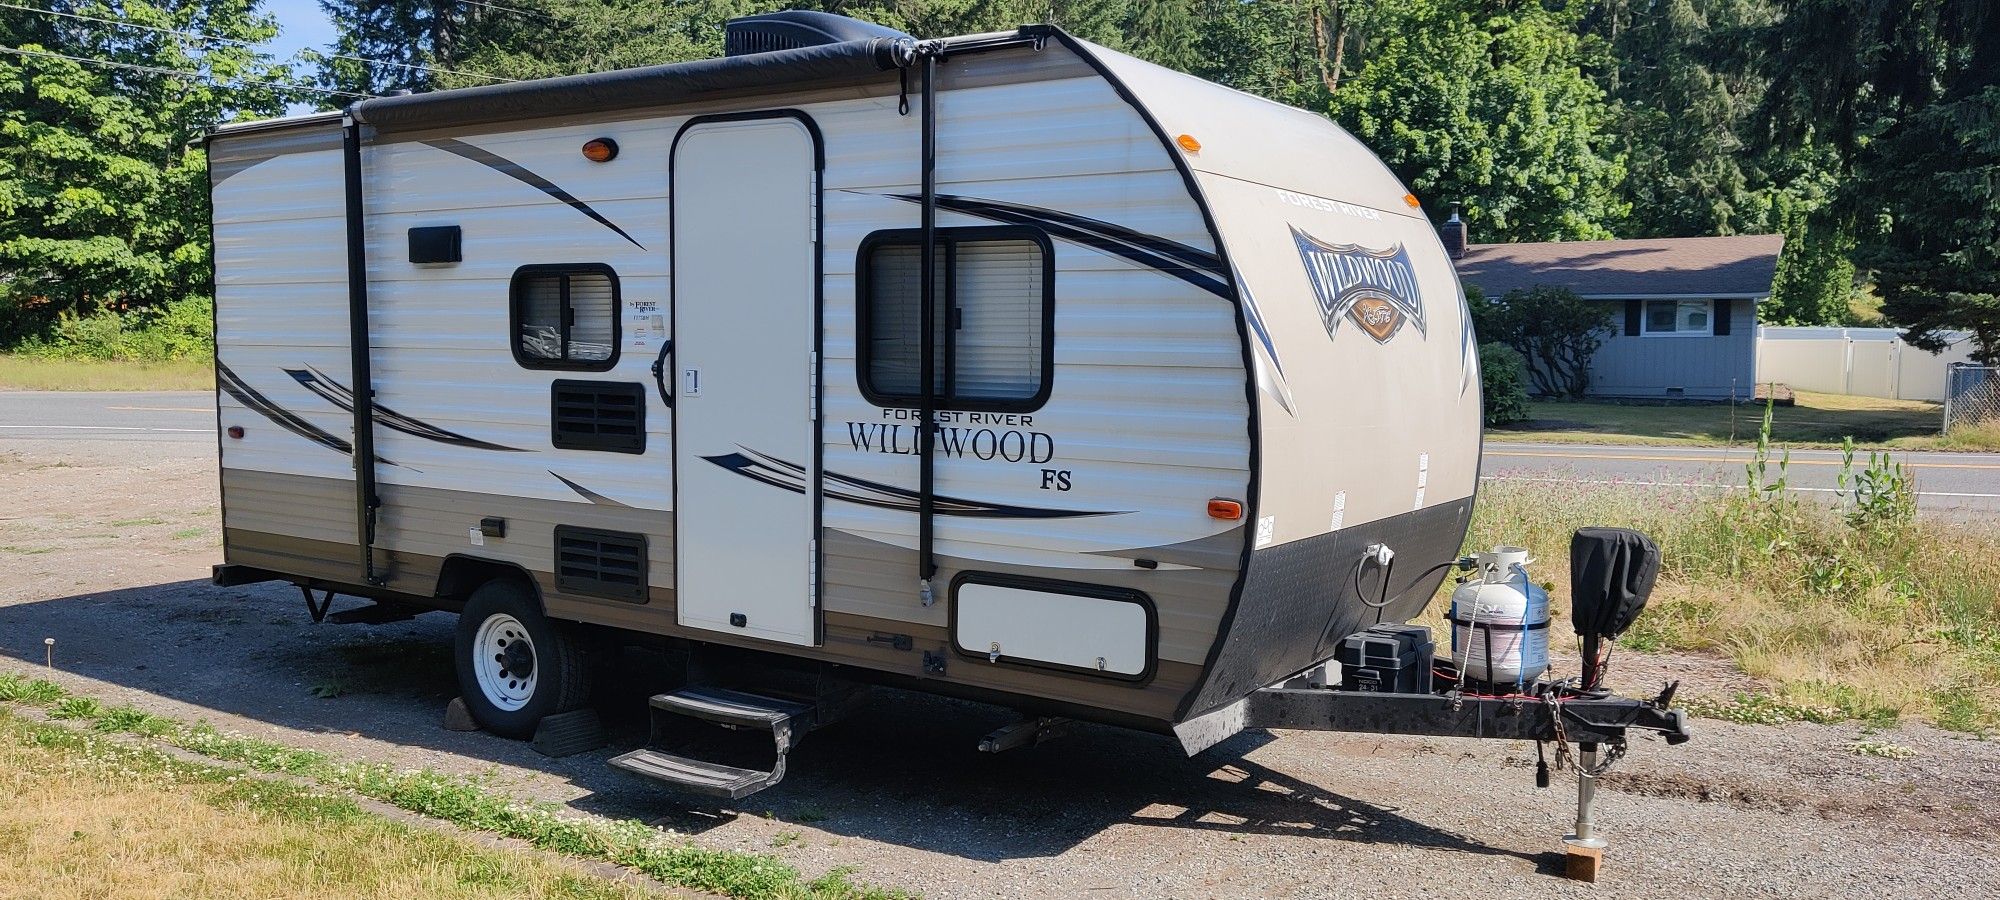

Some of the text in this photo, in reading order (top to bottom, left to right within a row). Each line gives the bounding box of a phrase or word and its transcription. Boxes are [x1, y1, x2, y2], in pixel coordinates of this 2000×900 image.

[1277, 190, 1382, 221] FOREST RIVER
[1307, 251, 1417, 308] WILDWOOD
[635, 301, 656, 309] FOREST
[969, 413, 1033, 427] RIVER
[1040, 468, 1072, 491] FS
